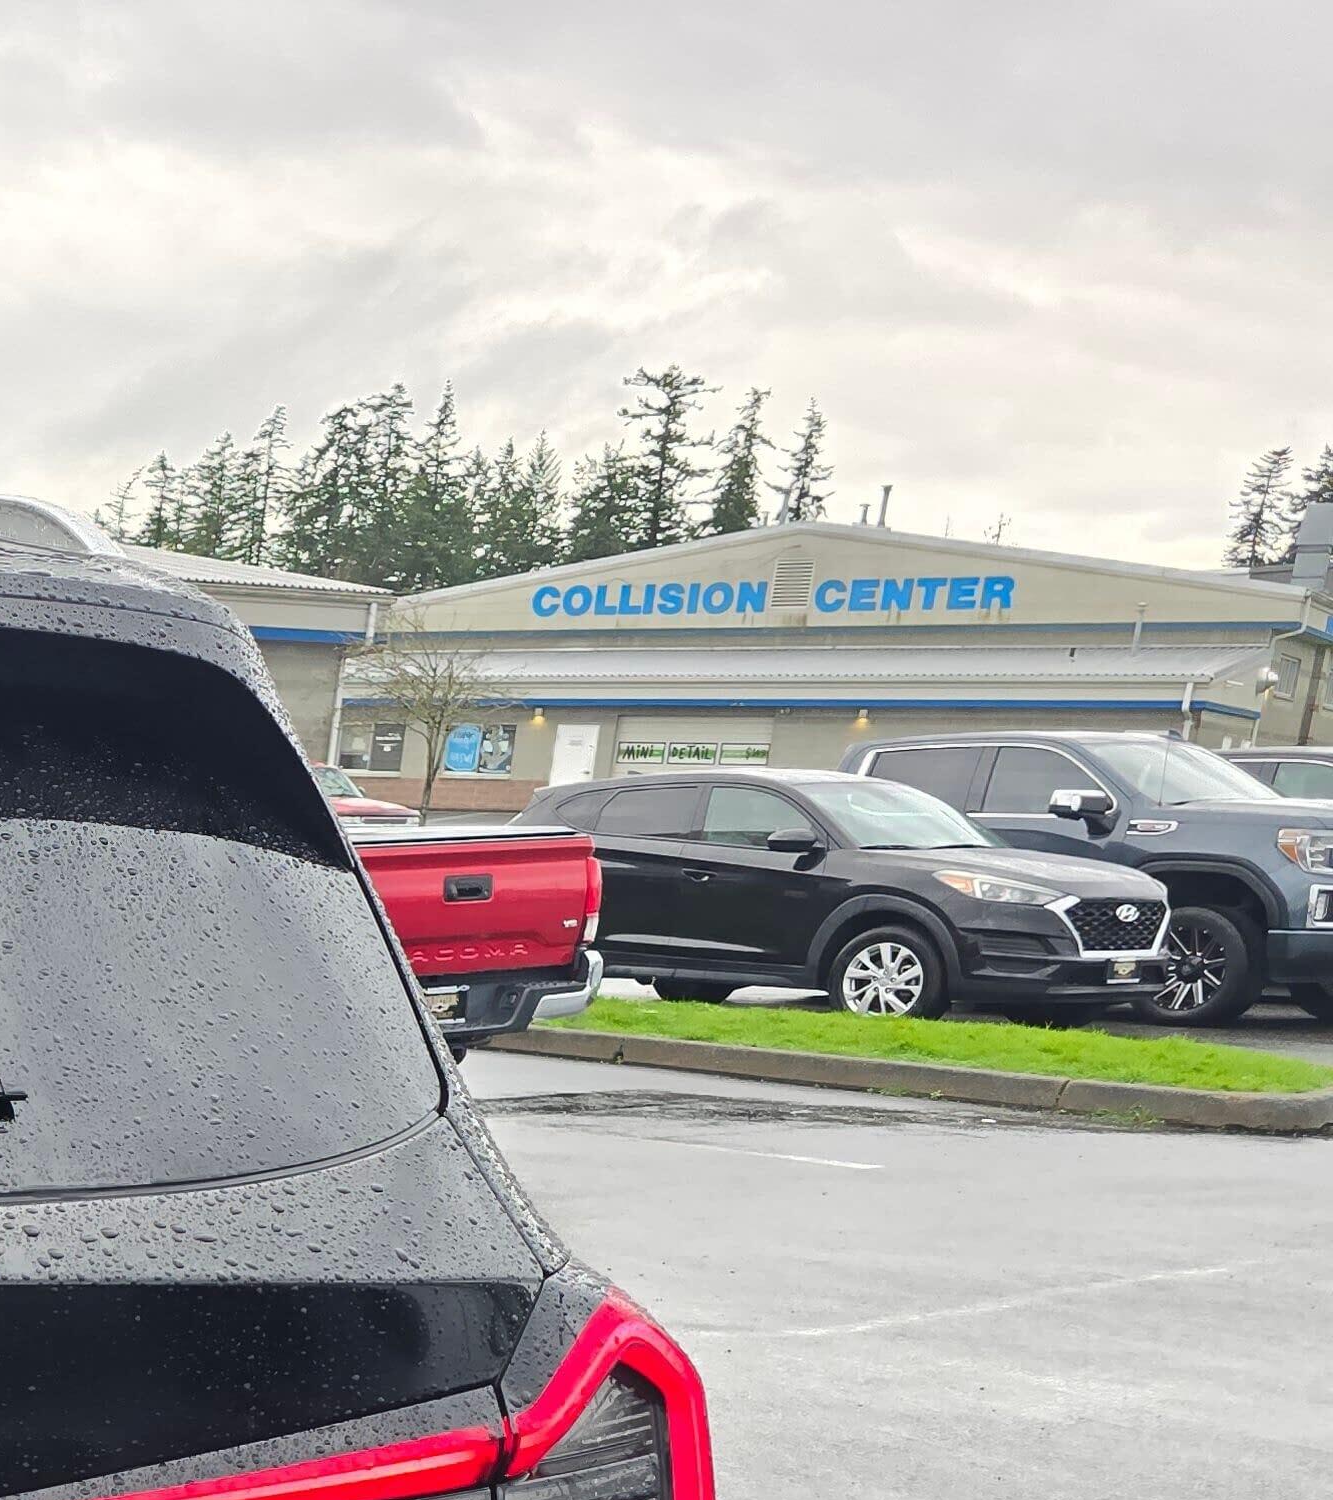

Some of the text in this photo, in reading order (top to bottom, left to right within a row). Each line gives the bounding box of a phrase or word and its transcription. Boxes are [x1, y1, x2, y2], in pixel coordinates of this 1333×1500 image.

[532, 575, 1015, 618] COLLISION CENTER
[407, 943, 529, 963] ACOMA
